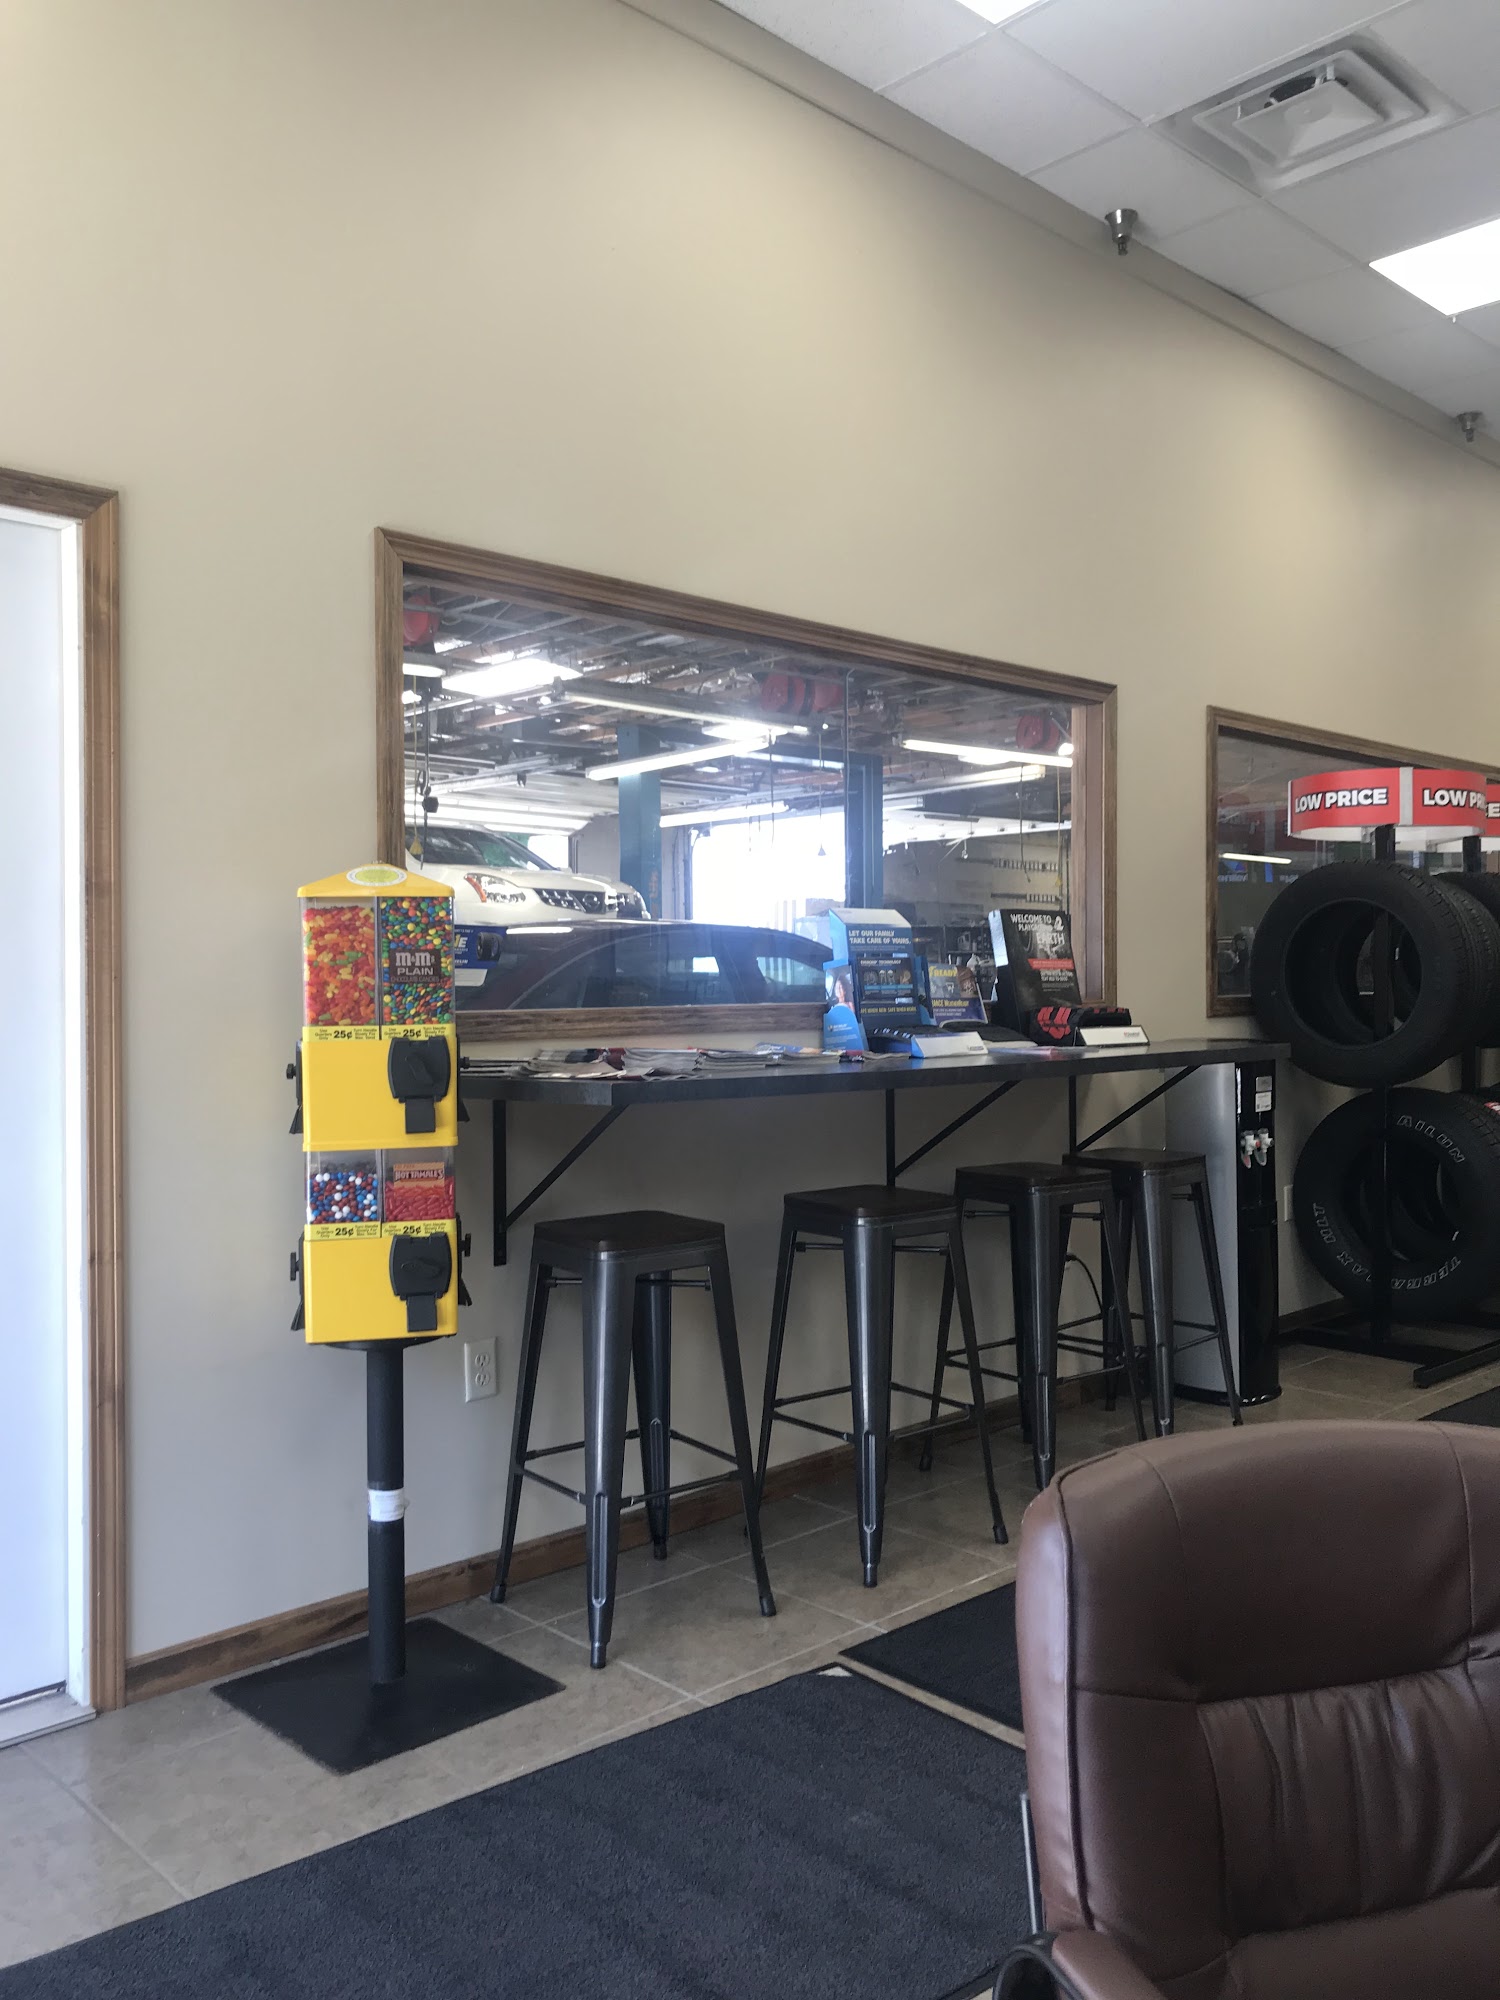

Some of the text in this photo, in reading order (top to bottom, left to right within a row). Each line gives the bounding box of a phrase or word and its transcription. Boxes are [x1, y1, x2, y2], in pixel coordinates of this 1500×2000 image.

[1294, 787, 1389, 814] LOW PRICE
[1423, 788, 1467, 807] LOW
[1010, 913, 1052, 924] WELCOME TO
[397, 967, 434, 976] PLAIN
[333, 1030, 352, 1040] 25¢
[403, 1029, 422, 1038] 25¢
[395, 1168, 444, 1181] HOT TAMALES
[335, 1227, 354, 1237] 25¢
[403, 1225, 422, 1235] 25¢
